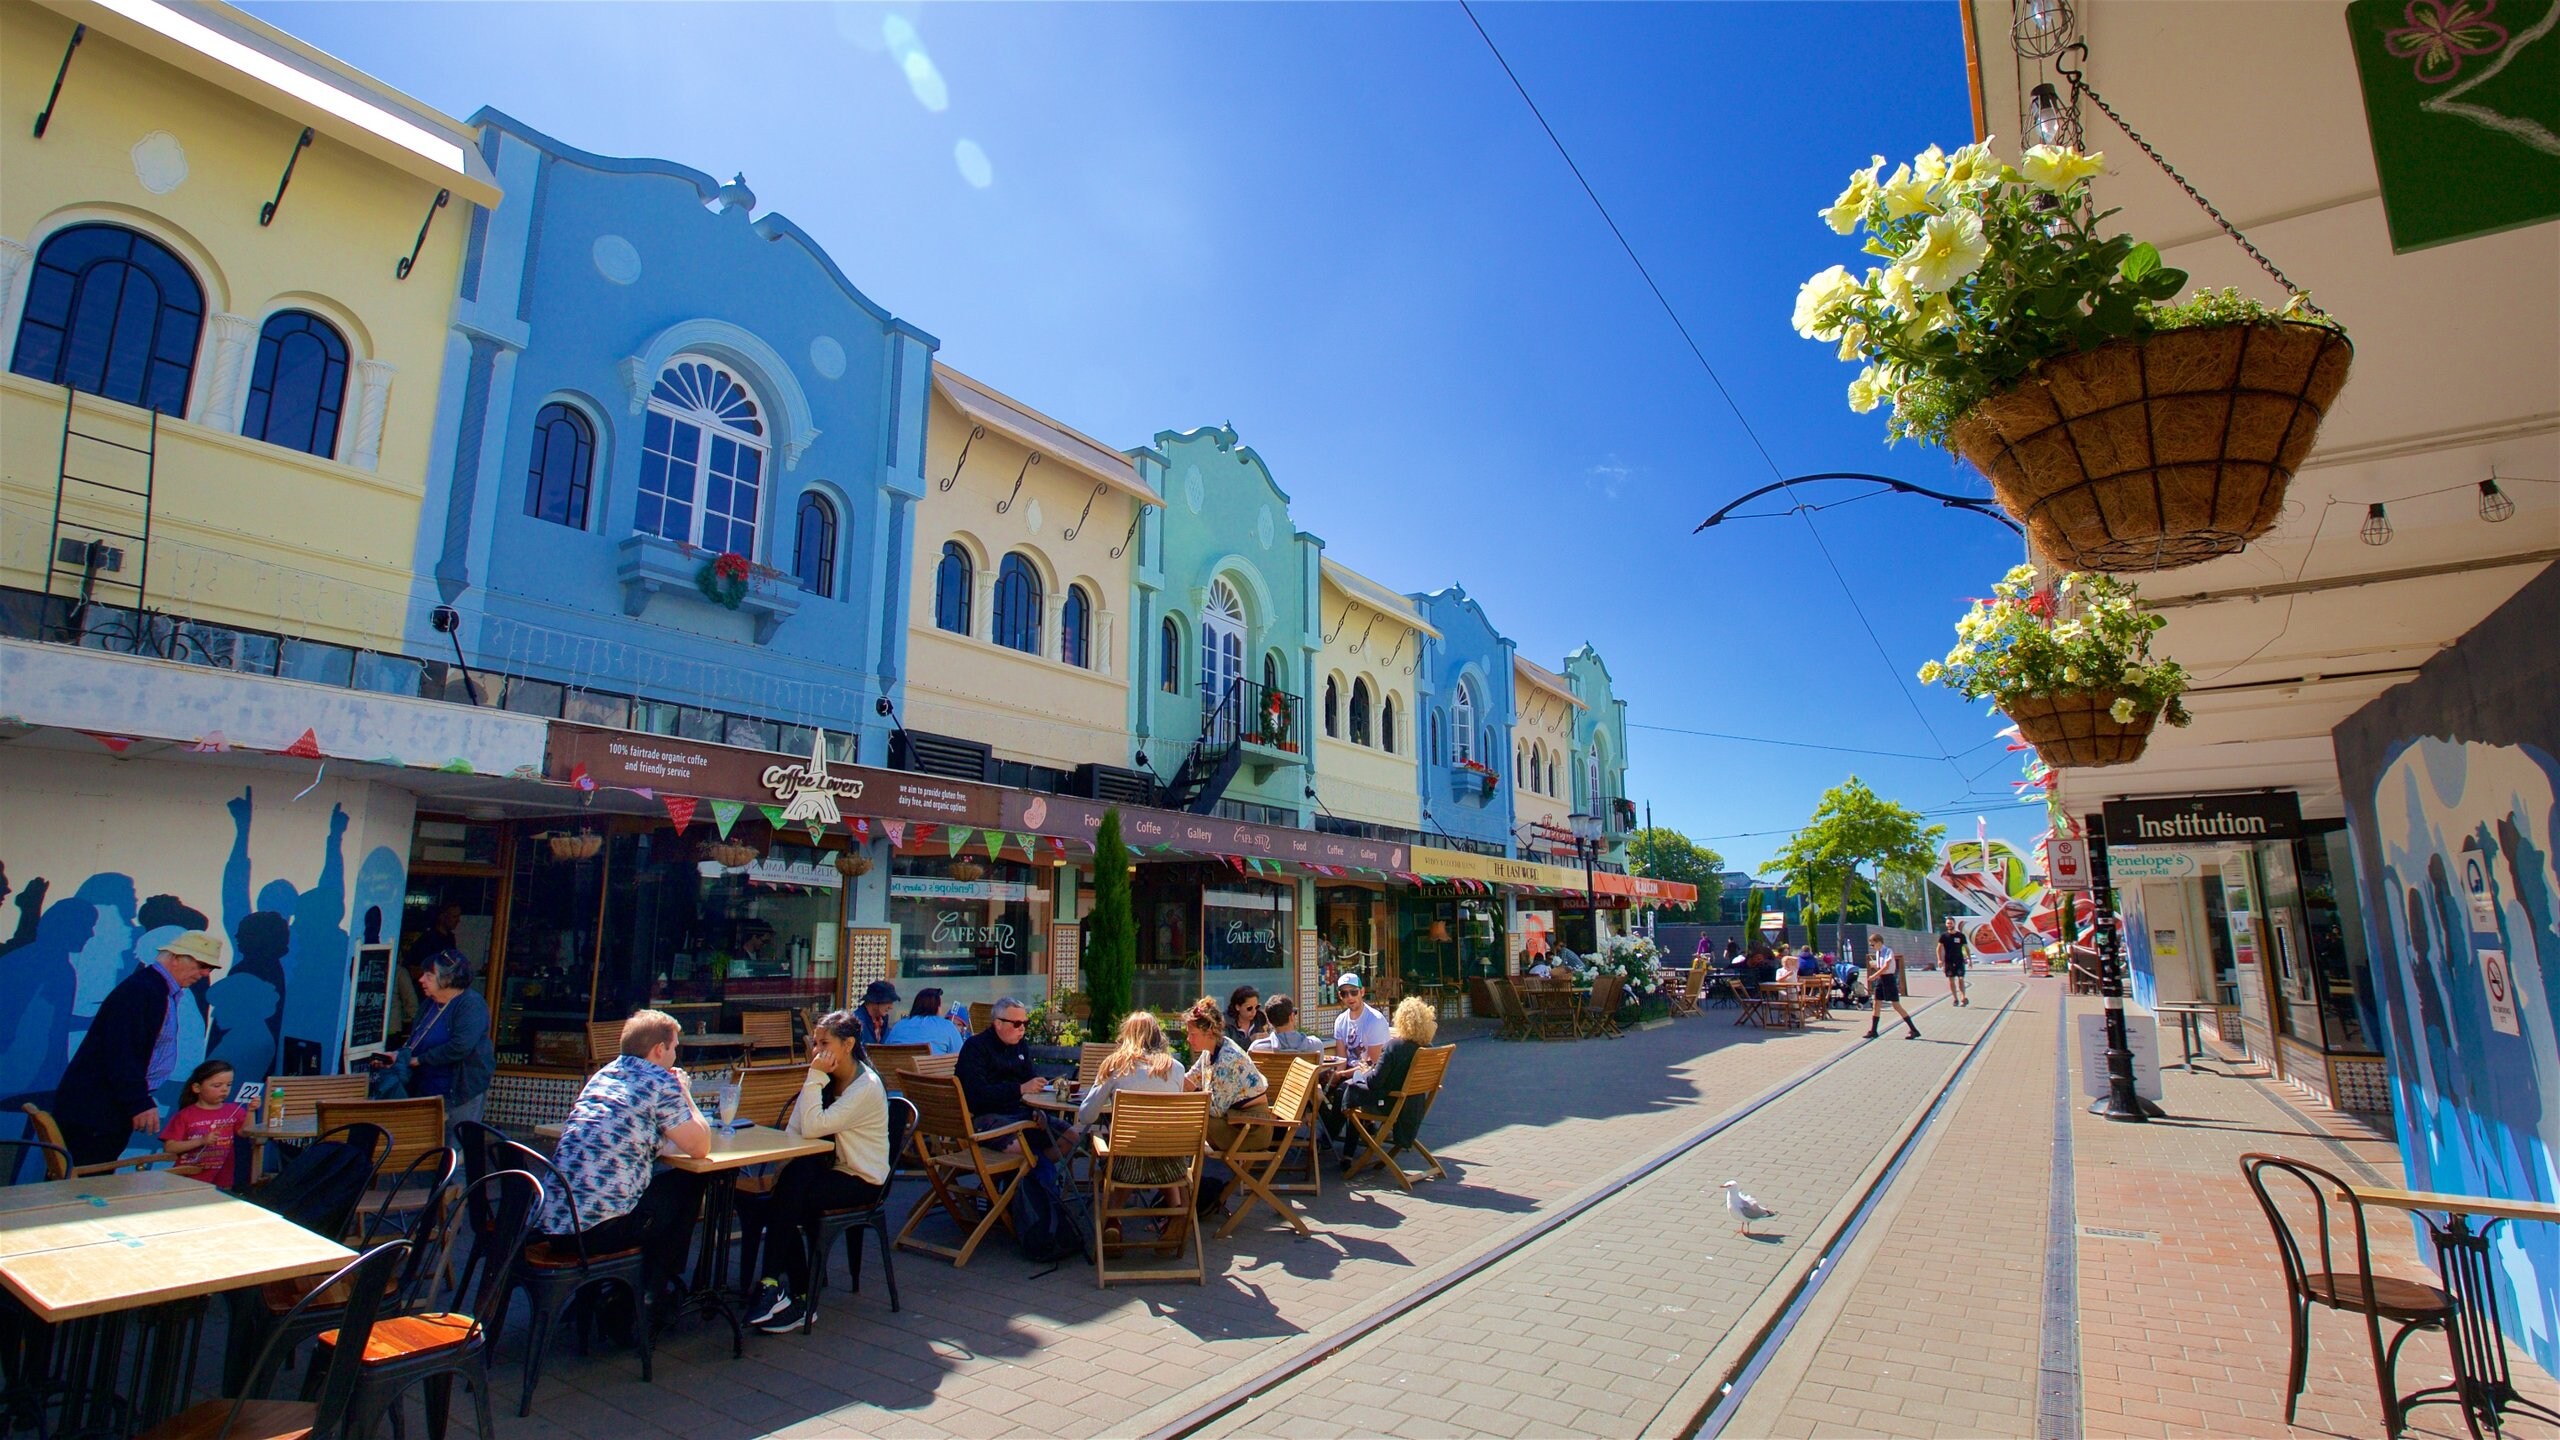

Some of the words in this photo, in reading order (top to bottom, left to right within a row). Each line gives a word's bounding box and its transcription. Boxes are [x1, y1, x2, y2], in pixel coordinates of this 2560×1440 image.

[609, 743, 629, 755] 100%
[630, 746, 660, 760] fairtrade
[661, 752, 686, 764] organic
[687, 755, 708, 766] coffee
[624, 761, 638, 772] and
[639, 762, 666, 777] friendly
[667, 766, 690, 778] service
[767, 768, 816, 795] Coffee
[816, 775, 862, 794] Lovers
[908, 785, 916, 794] aim
[918, 786, 923, 794] to
[924, 788, 941, 798] provide
[942, 789, 956, 800] gluten
[898, 795, 911, 807] dairy
[923, 799, 932, 808] and
[932, 801, 950, 811] organic
[950, 802, 966, 812] options
[1084, 814, 1103, 828] Foo
[1136, 821, 1162, 836] Coffee
[2136, 812, 2267, 838] Institution
[1188, 828, 1212, 844] Gallery
[1292, 840, 1307, 852] Food
[1327, 844, 1344, 856] Coffee
[1360, 848, 1377, 862] Gallery
[2107, 854, 2184, 868] Penelope's
[1494, 862, 1504, 876] THE
[1506, 864, 1520, 879] LAST
[2118, 868, 2148, 877] Cakery
[240, 1086, 259, 1100] 22
